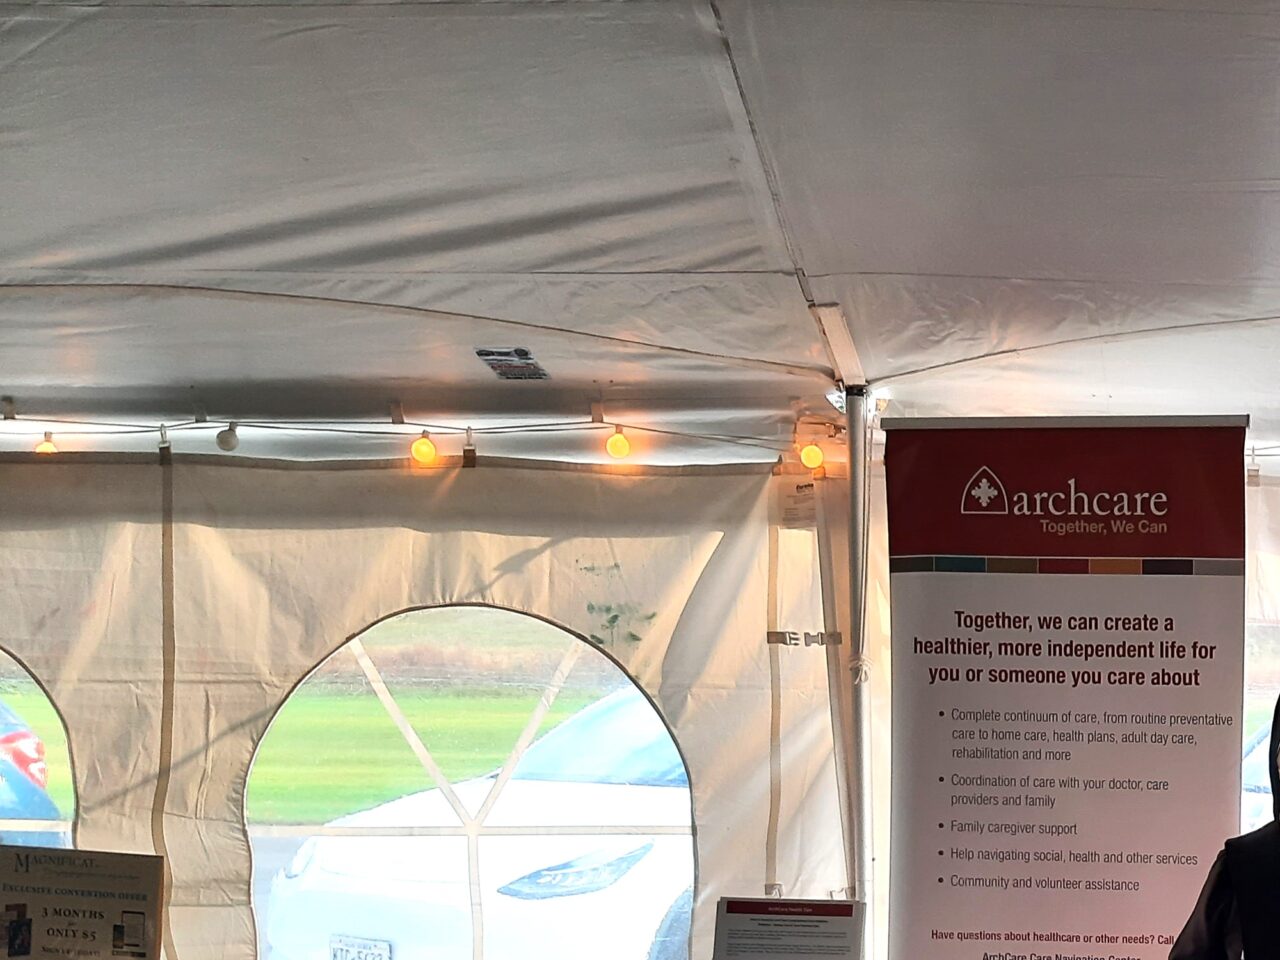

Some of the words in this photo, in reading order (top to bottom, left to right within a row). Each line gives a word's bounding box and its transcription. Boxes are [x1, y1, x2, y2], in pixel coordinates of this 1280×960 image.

[1013, 478, 1167, 515] archcare
[1040, 520, 1106, 535] Together,
[1111, 520, 1134, 533] We
[1138, 520, 1167, 533] Can
[954, 611, 1032, 632] Together,
[1038, 616, 1063, 629] we
[1068, 617, 1099, 630] can
[1105, 614, 1158, 631] create
[1164, 618, 1173, 631] a
[914, 637, 992, 659] healthier,
[999, 643, 1041, 656] more
[1048, 640, 1154, 661] independent
[1159, 641, 1186, 658] life
[1192, 641, 1216, 659] for
[929, 668, 959, 684] you
[966, 669, 983, 682] or
[989, 669, 1065, 683] someone
[1072, 671, 1101, 687] you
[1108, 672, 1145, 685] care
[1151, 668, 1200, 685] about
[952, 708, 1000, 723] Complete
[1004, 710, 1059, 722] continuum
[1062, 711, 1071, 722] of
[1075, 714, 1099, 724] care,
[1103, 712, 1128, 723] from
[1131, 713, 1166, 724] routine
[1170, 714, 1232, 726] preventative
[952, 729, 976, 739] care
[978, 729, 989, 740] to
[991, 729, 1020, 740] home
[1024, 731, 1049, 742] care,
[1052, 730, 1085, 742] health
[1088, 730, 1117, 744] plans,
[1122, 731, 1147, 743] adult
[1151, 732, 1168, 746] day
[1171, 735, 1197, 745] care,
[952, 747, 1020, 760] rehabilitation
[1023, 749, 1041, 760] and
[1045, 750, 1071, 760] more
[951, 774, 1017, 786] Coordination
[1020, 776, 1030, 787] of
[1033, 777, 1055, 788] care
[1059, 777, 1079, 788] with
[1083, 780, 1105, 791] your
[1109, 778, 1143, 791] doctor,
[1147, 780, 1168, 790] care
[951, 793, 1000, 806] providers
[1002, 795, 1022, 806] and
[1025, 795, 1056, 809] family
[951, 820, 985, 835] Family
[988, 823, 1036, 835] caregiver
[1039, 824, 1077, 836] support
[951, 848, 974, 861] Help
[978, 849, 1031, 863] navigating
[1034, 850, 1065, 863] social,
[1069, 850, 1101, 862] health
[1104, 852, 1123, 863] and
[1126, 852, 1153, 863] other
[1156, 853, 1197, 865] services
[951, 875, 1010, 890] Community
[1013, 877, 1032, 888] and
[1035, 877, 1082, 889] volunteer
[1085, 879, 1139, 891] assistance
[55, 888, 116, 899] CONVENTION
[41, 907, 48, 918] 3
[53, 907, 105, 920] MONTHS
[46, 927, 78, 938] ONLY
[932, 930, 954, 939] Have
[957, 931, 1001, 941] questions
[1005, 932, 1031, 941] about
[1032, 932, 1080, 942] healthcare
[1095, 934, 1119, 943] other
[1122, 935, 1155, 944] needs?
[1158, 935, 1174, 945] Call
